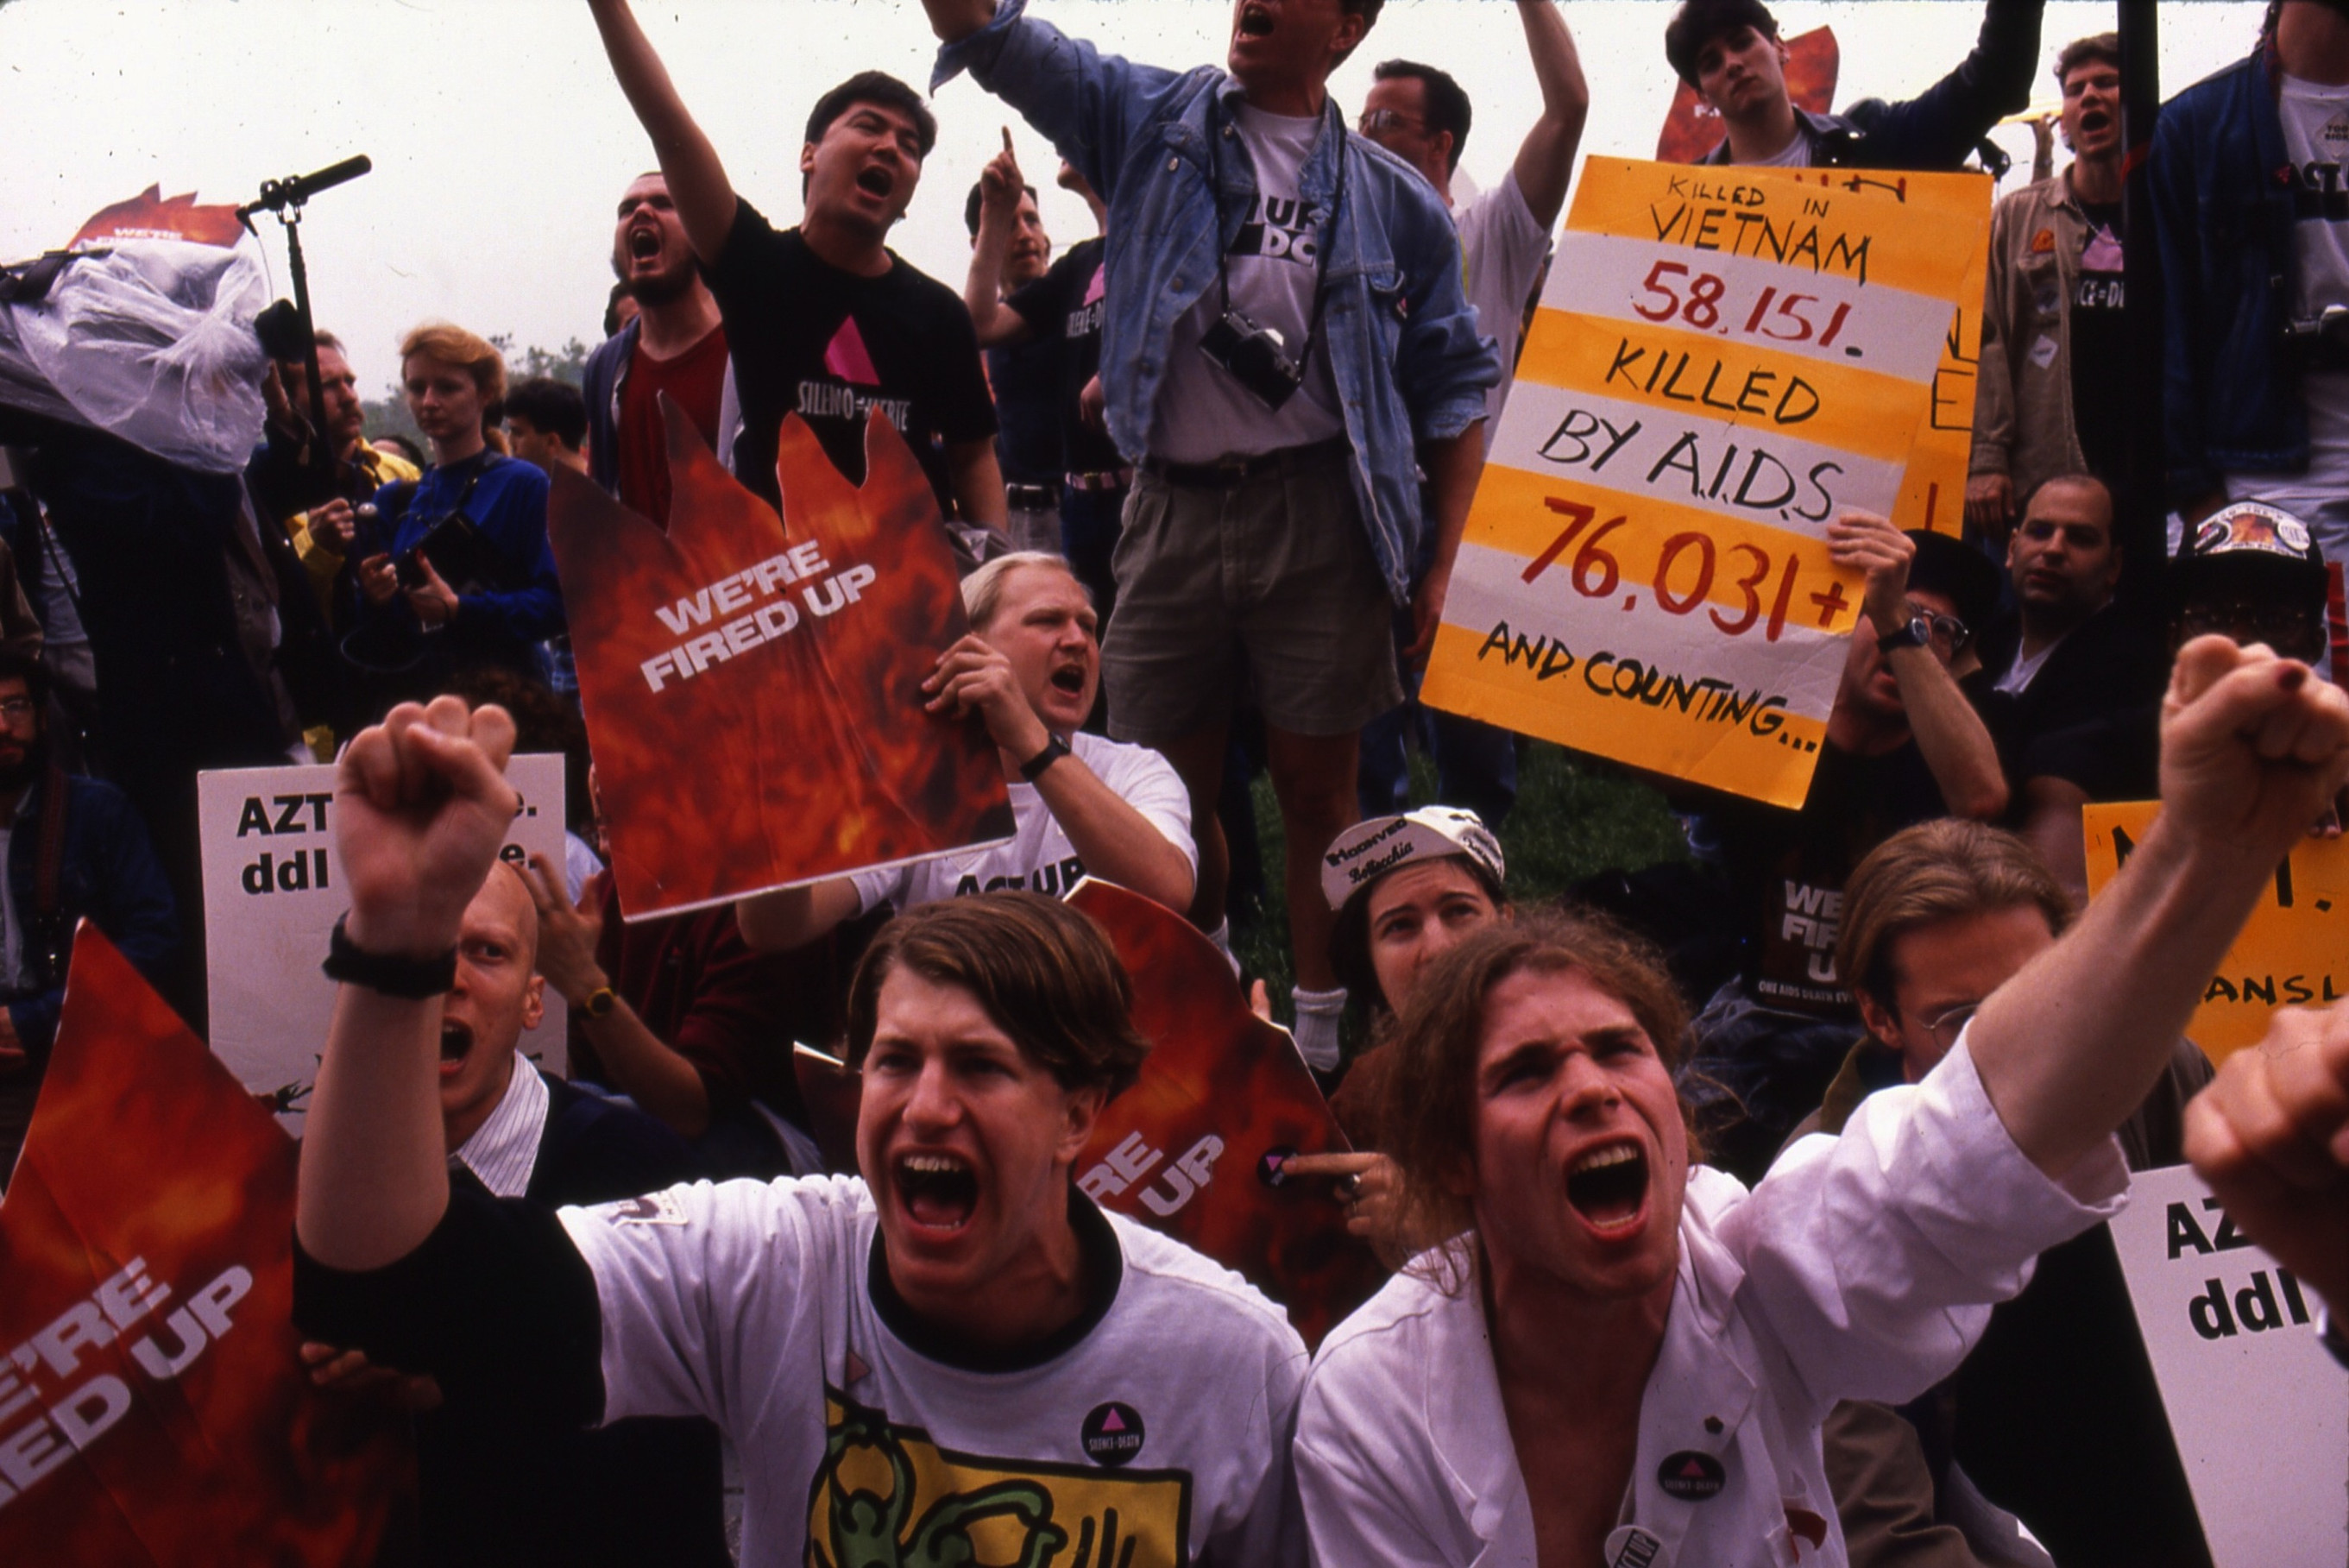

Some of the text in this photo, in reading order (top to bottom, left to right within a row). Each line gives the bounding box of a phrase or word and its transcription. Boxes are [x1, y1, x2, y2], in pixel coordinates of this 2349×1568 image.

[1668, 174, 1829, 217] KILLED IN
[1650, 203, 1872, 287] VIETNAM
[1605, 337, 1819, 425] KILLED
[1537, 409, 1642, 472] BY
[640, 563, 876, 694] FIRED UP
[655, 538, 830, 636] WE'RE
[236, 793, 333, 837] AZT
[1033, 856, 1086, 898] UP
[1808, 953, 1837, 982] U
[1137, 1134, 1225, 1217] UP
[2167, 1193, 2259, 1260] AZ
[0, 1256, 172, 1423] E'RE
[130, 1264, 254, 1379] UP
